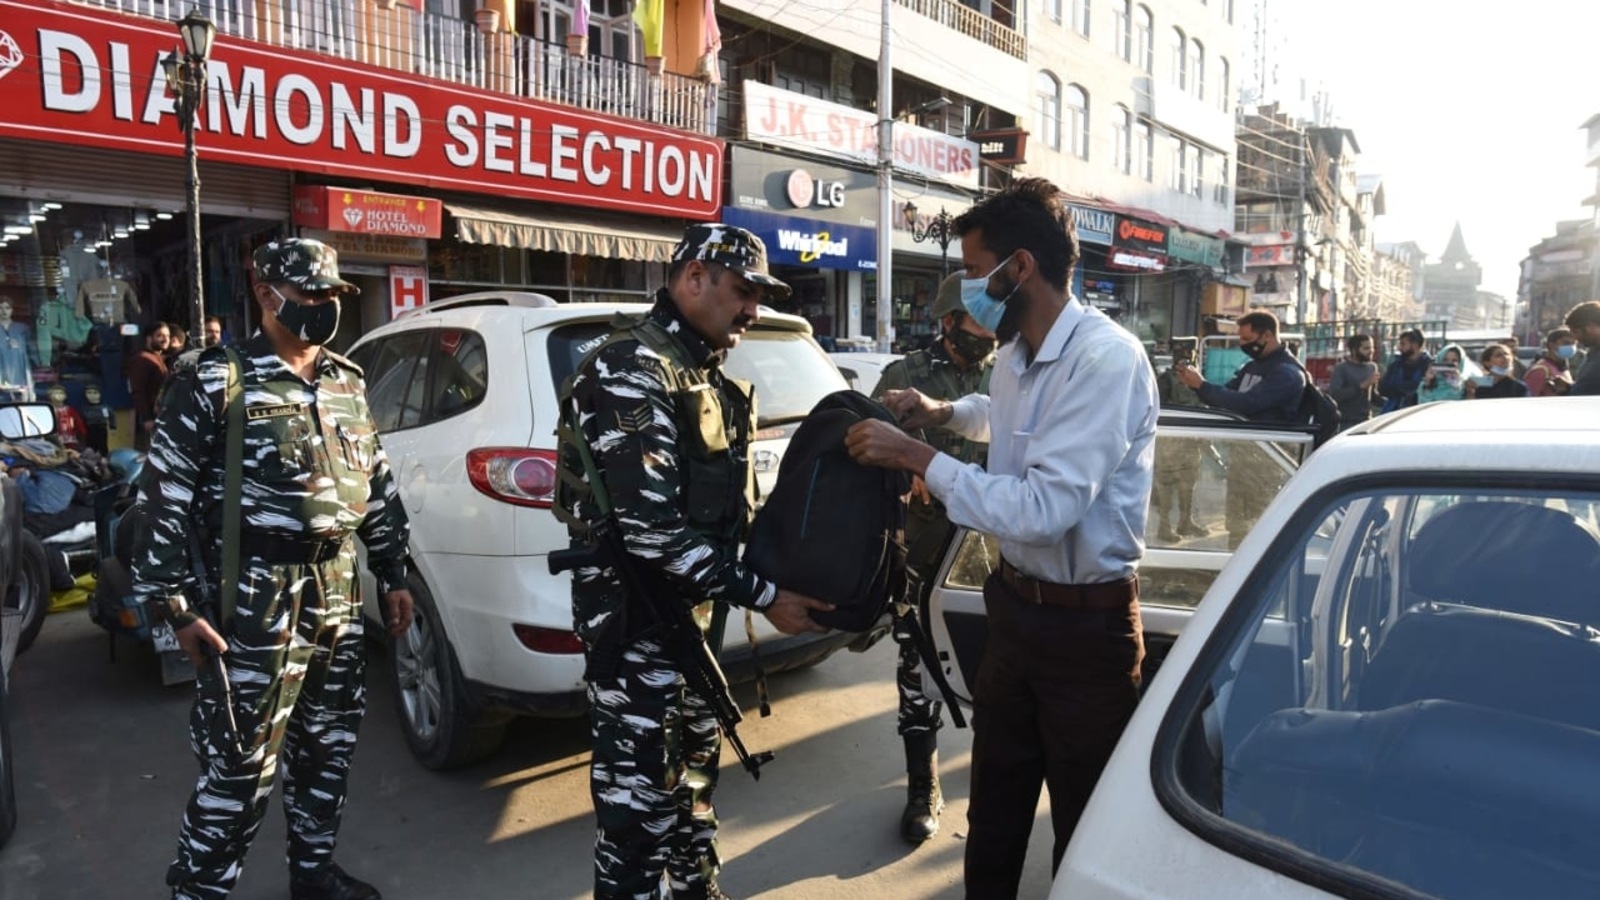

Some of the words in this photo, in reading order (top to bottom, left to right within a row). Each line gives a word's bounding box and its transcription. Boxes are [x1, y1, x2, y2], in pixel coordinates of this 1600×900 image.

[37, 28, 422, 159] DIAMOND
[444, 104, 714, 202] SELECTION
[761, 97, 818, 142] J.K.
[827, 112, 973, 177] STAIONERS
[817, 179, 846, 207] LG
[367, 210, 407, 223] HOTEL
[367, 220, 426, 235] DIAMOND
[777, 229, 849, 260] Whirlpool
[395, 277, 424, 307] H
